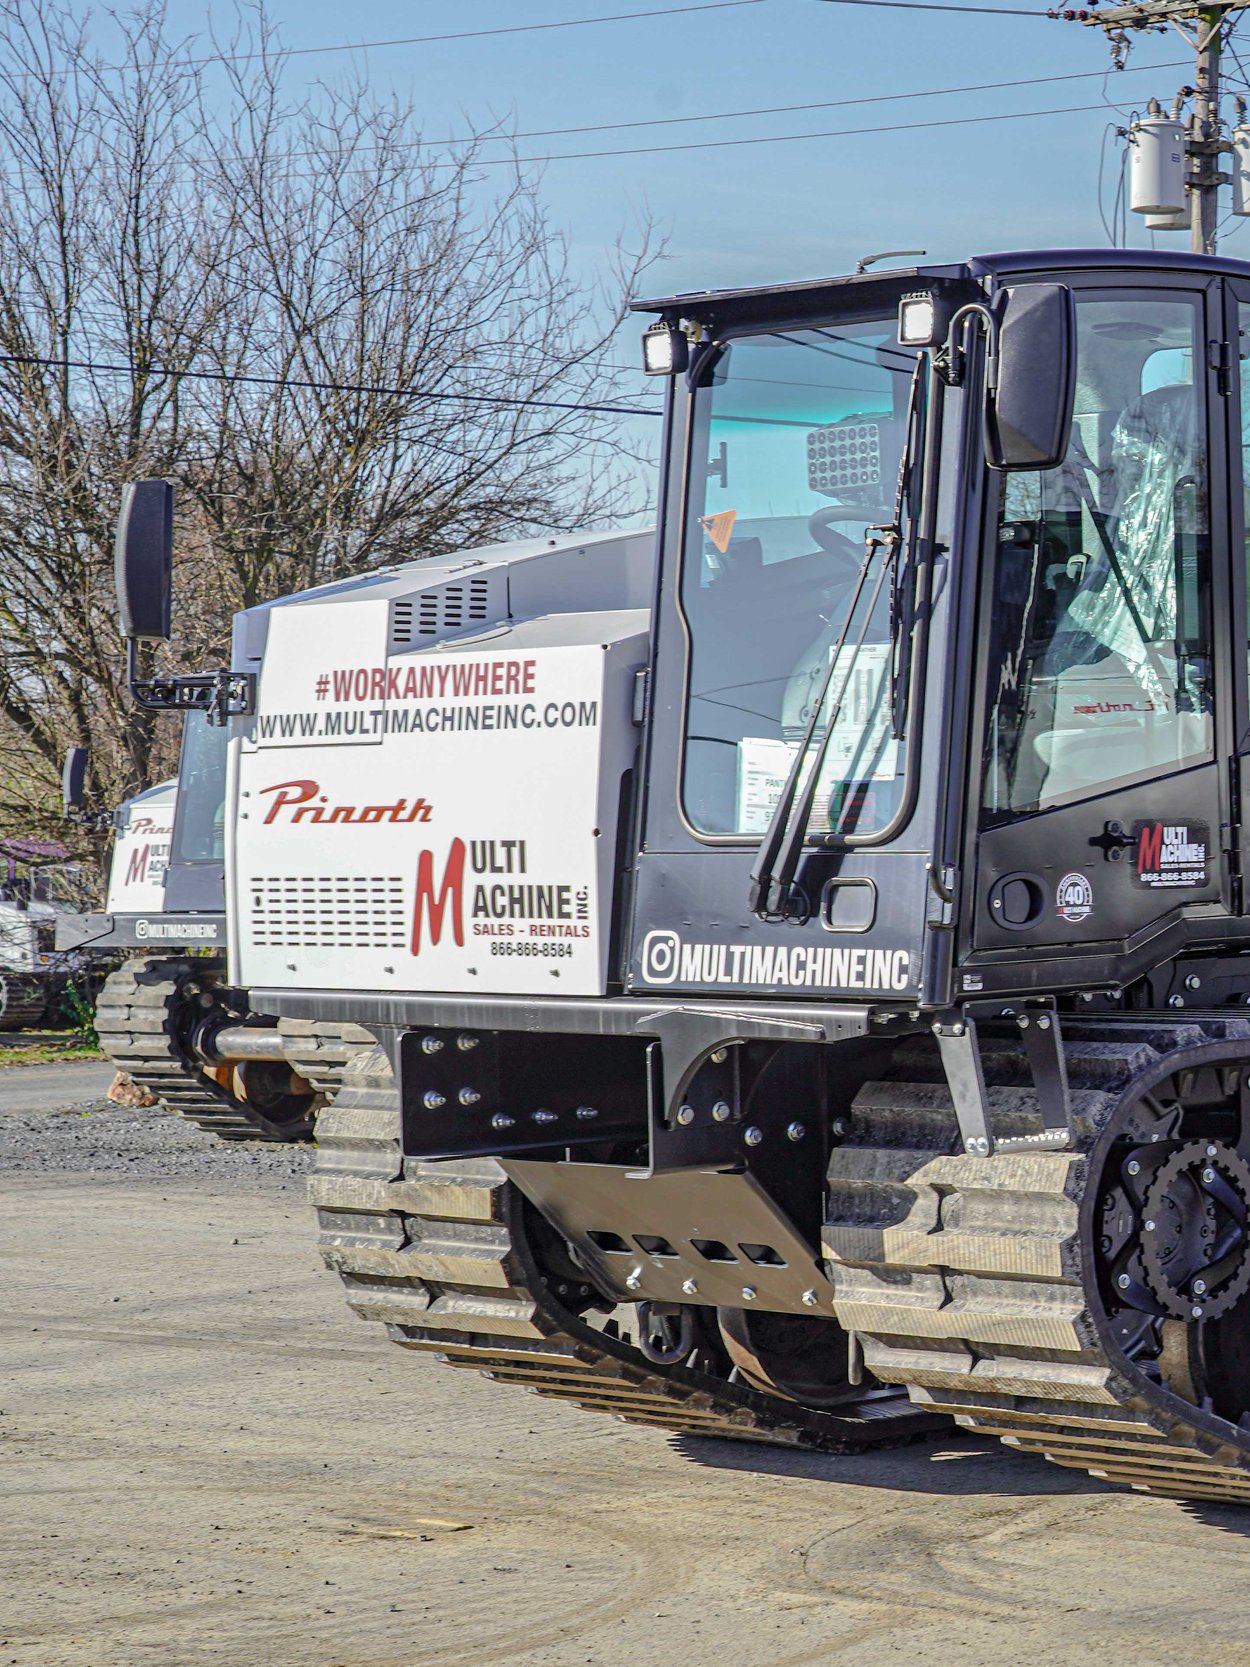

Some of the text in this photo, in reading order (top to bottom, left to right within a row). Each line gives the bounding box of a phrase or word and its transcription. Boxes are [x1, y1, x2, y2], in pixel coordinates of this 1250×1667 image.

[315, 660, 536, 702] #WORKANYWHERE
[259, 701, 598, 738] WWW.MULTIMACHINEINC.COM
[260, 780, 433, 824] Prinoth
[576, 886, 589, 920] INC.
[1065, 886, 1084, 905] 40
[473, 923, 514, 936] SALES
[529, 924, 590, 938] RENTALS
[491, 941, 573, 957] 866-866-8584
[680, 944, 909, 990] MULTIMACHINEINC
